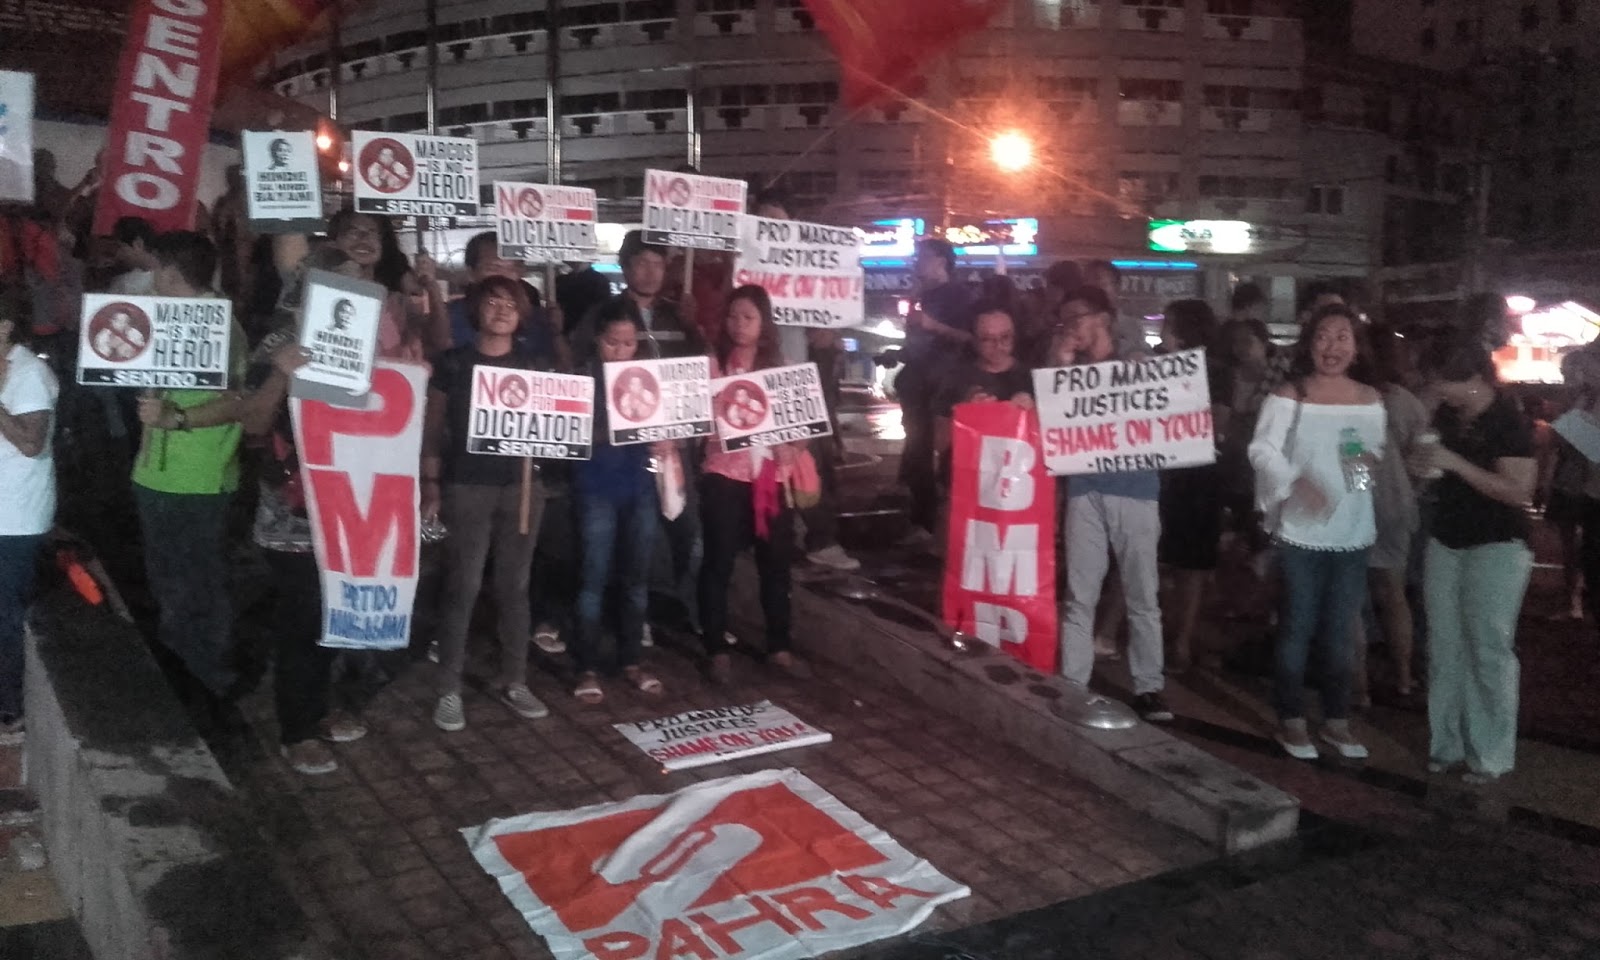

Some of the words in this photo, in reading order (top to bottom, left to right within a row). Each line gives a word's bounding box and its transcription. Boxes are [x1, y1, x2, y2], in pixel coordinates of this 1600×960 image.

[415, 140, 473, 161] MARCOS
[418, 172, 474, 200] HERO!
[757, 221, 791, 242] PRO
[798, 225, 857, 246] MARCOS
[758, 247, 839, 269] JUSTICES
[155, 303, 225, 325] MARCOS
[154, 339, 222, 369] HERO!
[1053, 367, 1099, 394] PRO
[1111, 353, 1199, 388] MARCOS
[477, 371, 529, 409] NO
[1065, 387, 1169, 418] JUSTICES
[771, 396, 824, 426] HERO!
[1046, 422, 1119, 456] SHAME
[1126, 419, 1152, 446] ON
[1157, 409, 1213, 442] YOU!
[961, 435, 1039, 648] BMP
[658, 717, 758, 743] JUSTICES
[651, 736, 719, 762] SHAME
[719, 731, 754, 748] ON
